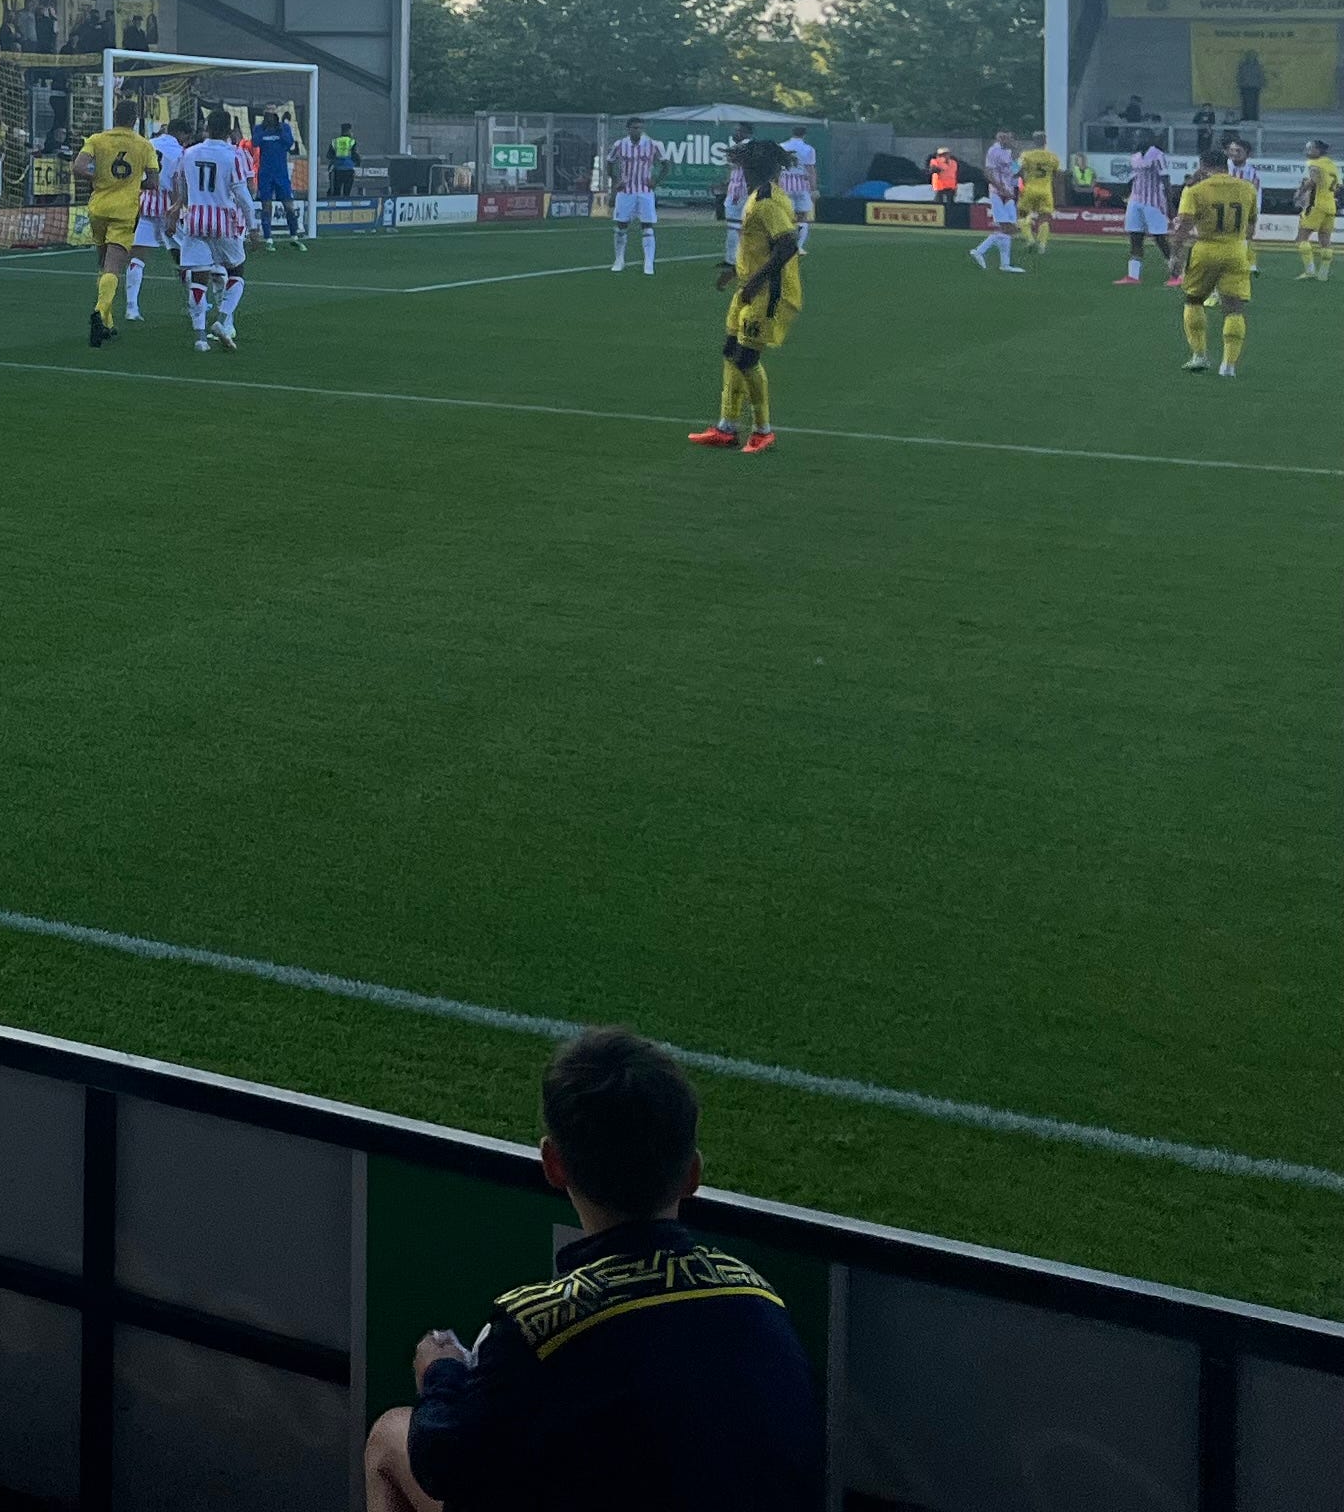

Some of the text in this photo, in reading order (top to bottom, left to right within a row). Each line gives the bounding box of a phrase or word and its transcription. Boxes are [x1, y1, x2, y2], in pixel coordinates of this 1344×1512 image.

[110, 151, 133, 180] 6
[656, 134, 737, 166] wills
[195, 160, 218, 193] 11
[1211, 202, 1243, 233] 11
